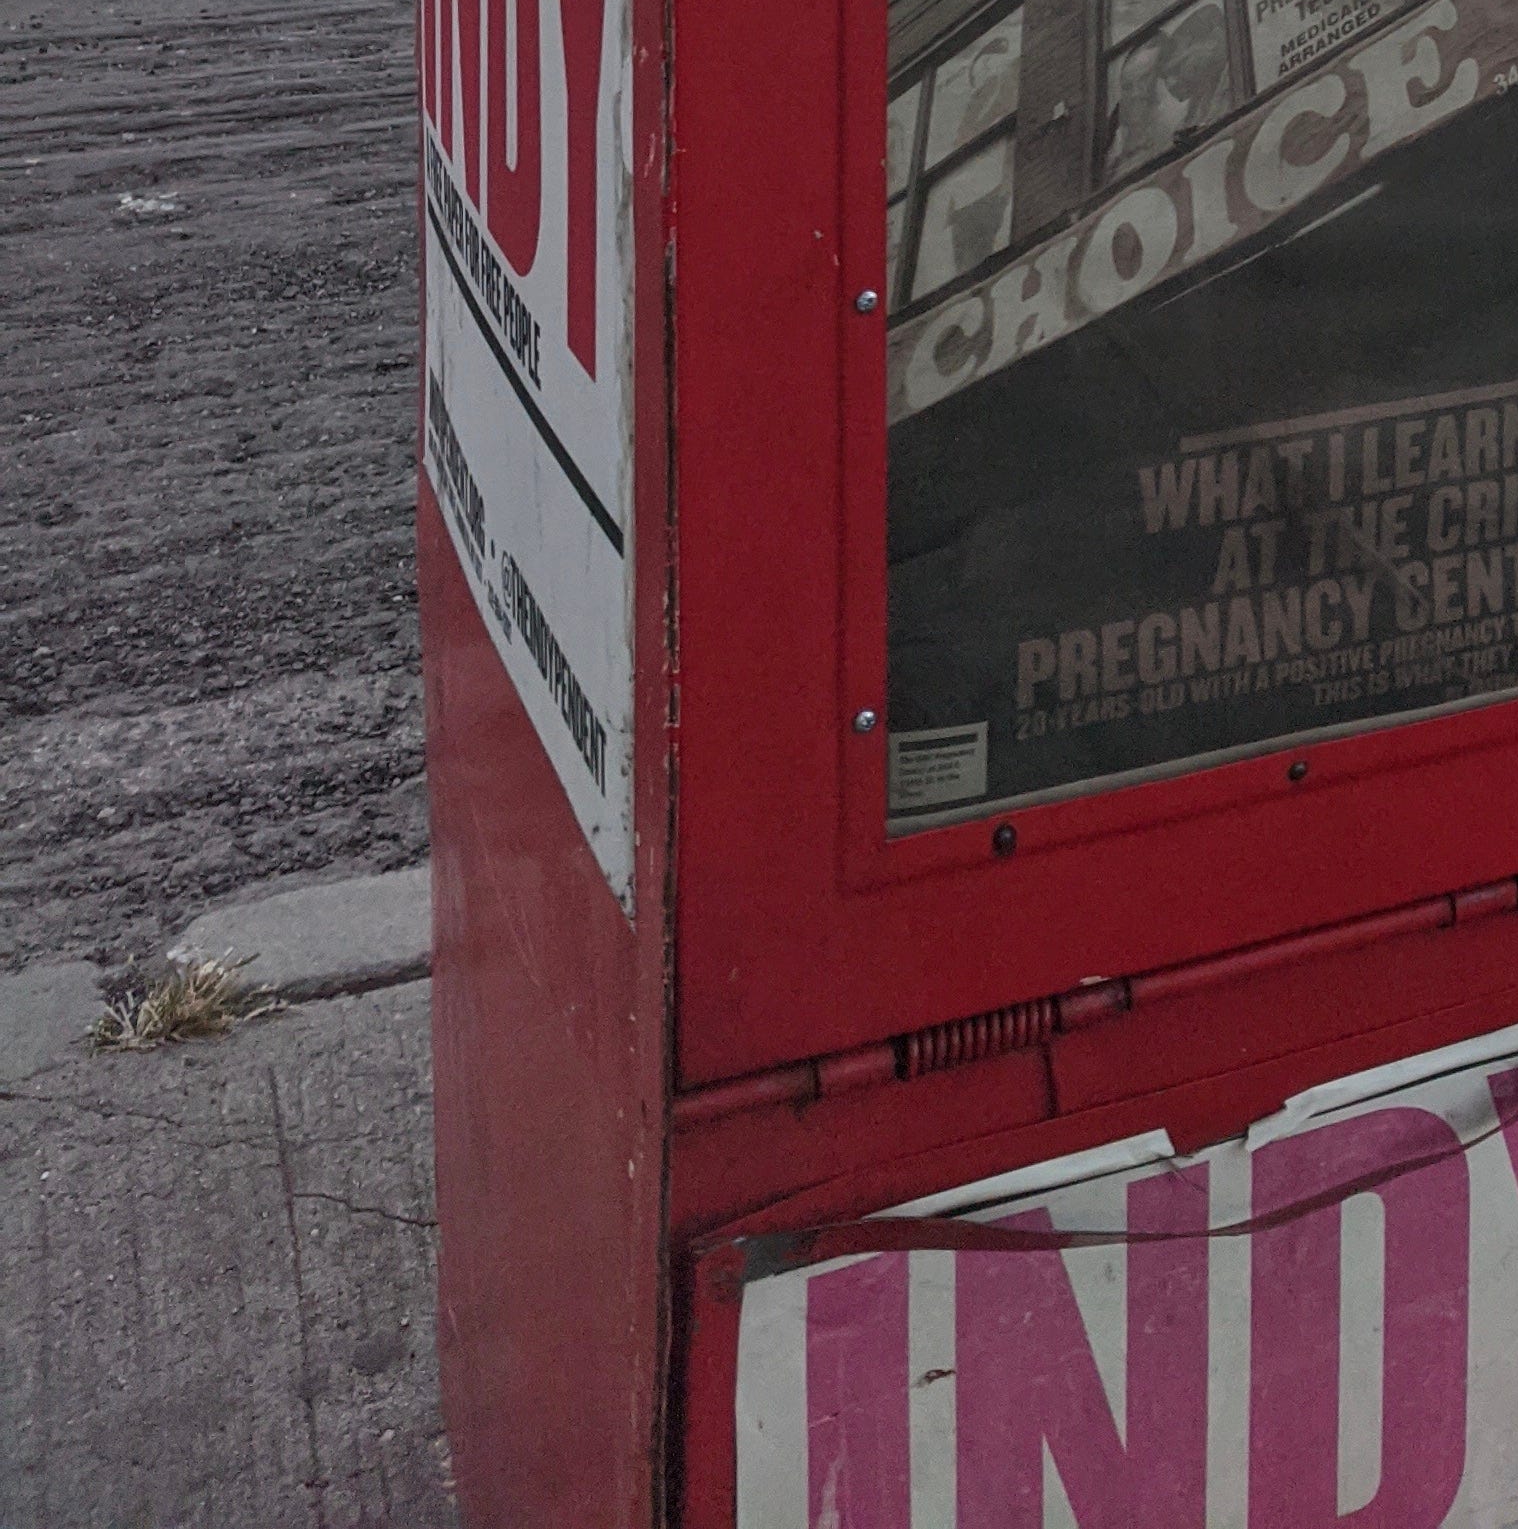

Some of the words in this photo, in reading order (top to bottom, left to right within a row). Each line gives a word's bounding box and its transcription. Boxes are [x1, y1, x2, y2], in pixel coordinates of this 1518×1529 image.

[1277, 2, 1381, 77] ARRANGED
[466, 207, 480, 290] FOR
[481, 231, 502, 326] FREE
[503, 273, 542, 392] PEOPLE
[1138, 438, 1313, 534] WHAT
[1328, 429, 1346, 502] I
[1212, 518, 1286, 597] AT
[1305, 492, 1412, 576] THE
[1015, 572, 1379, 712] PREGNANCY
[1191, 667, 1251, 703] WITH
[1274, 645, 1375, 685] POSITIVE
[1379, 613, 1507, 665] PREGNANCY
[1313, 675, 1363, 707] THIS
[1368, 670, 1392, 695] IS
